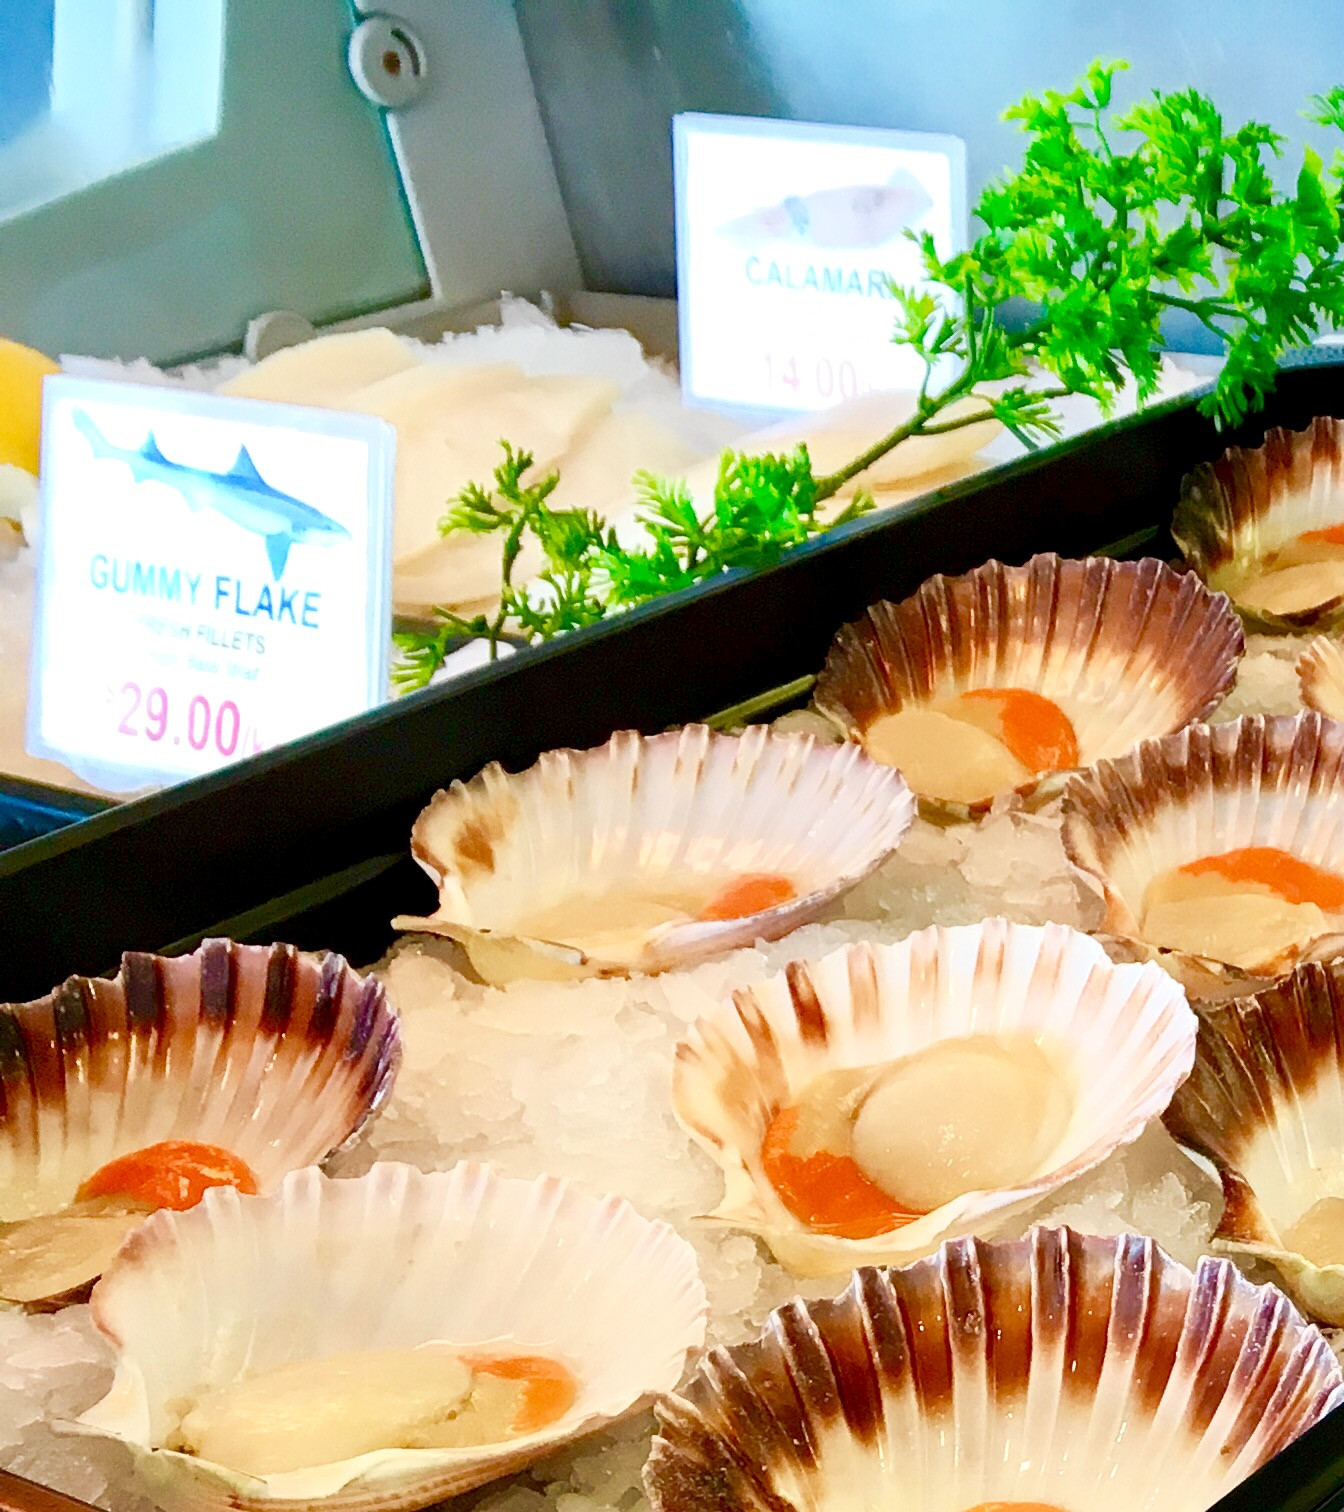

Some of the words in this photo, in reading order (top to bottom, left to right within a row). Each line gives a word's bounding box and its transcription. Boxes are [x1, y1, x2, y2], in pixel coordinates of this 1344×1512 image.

[745, 255, 894, 300] CALAMAR
[90, 554, 202, 606] GUMMY
[214, 575, 322, 629] FLAKE
